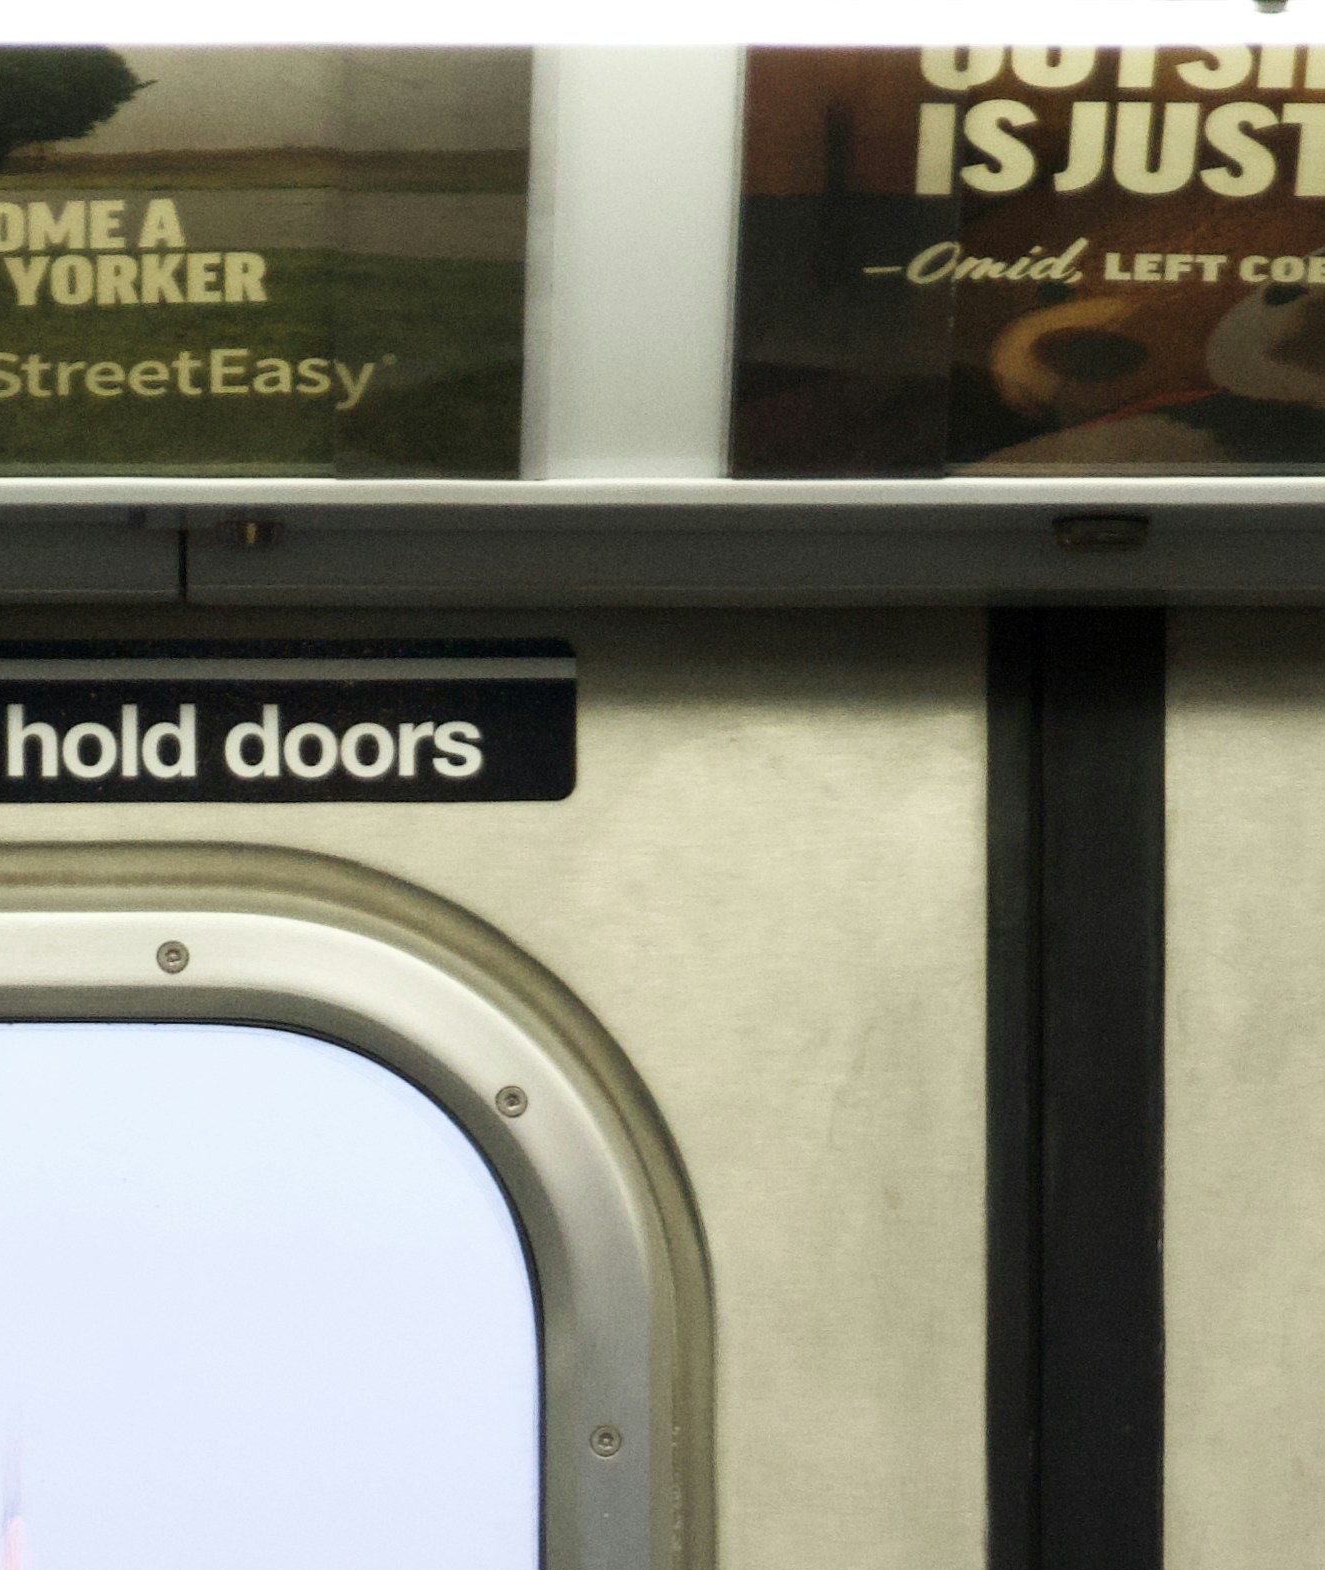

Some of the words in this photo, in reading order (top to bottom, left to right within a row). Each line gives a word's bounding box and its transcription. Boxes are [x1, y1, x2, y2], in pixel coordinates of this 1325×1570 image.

[915, 98, 1038, 195] IS
[1053, 99, 1325, 198] JUST
[137, 198, 186, 249] A
[3, 252, 268, 306] YORKER
[1103, 251, 1229, 284] LEFT
[6, 703, 197, 780] hold
[223, 703, 484, 780] doors
